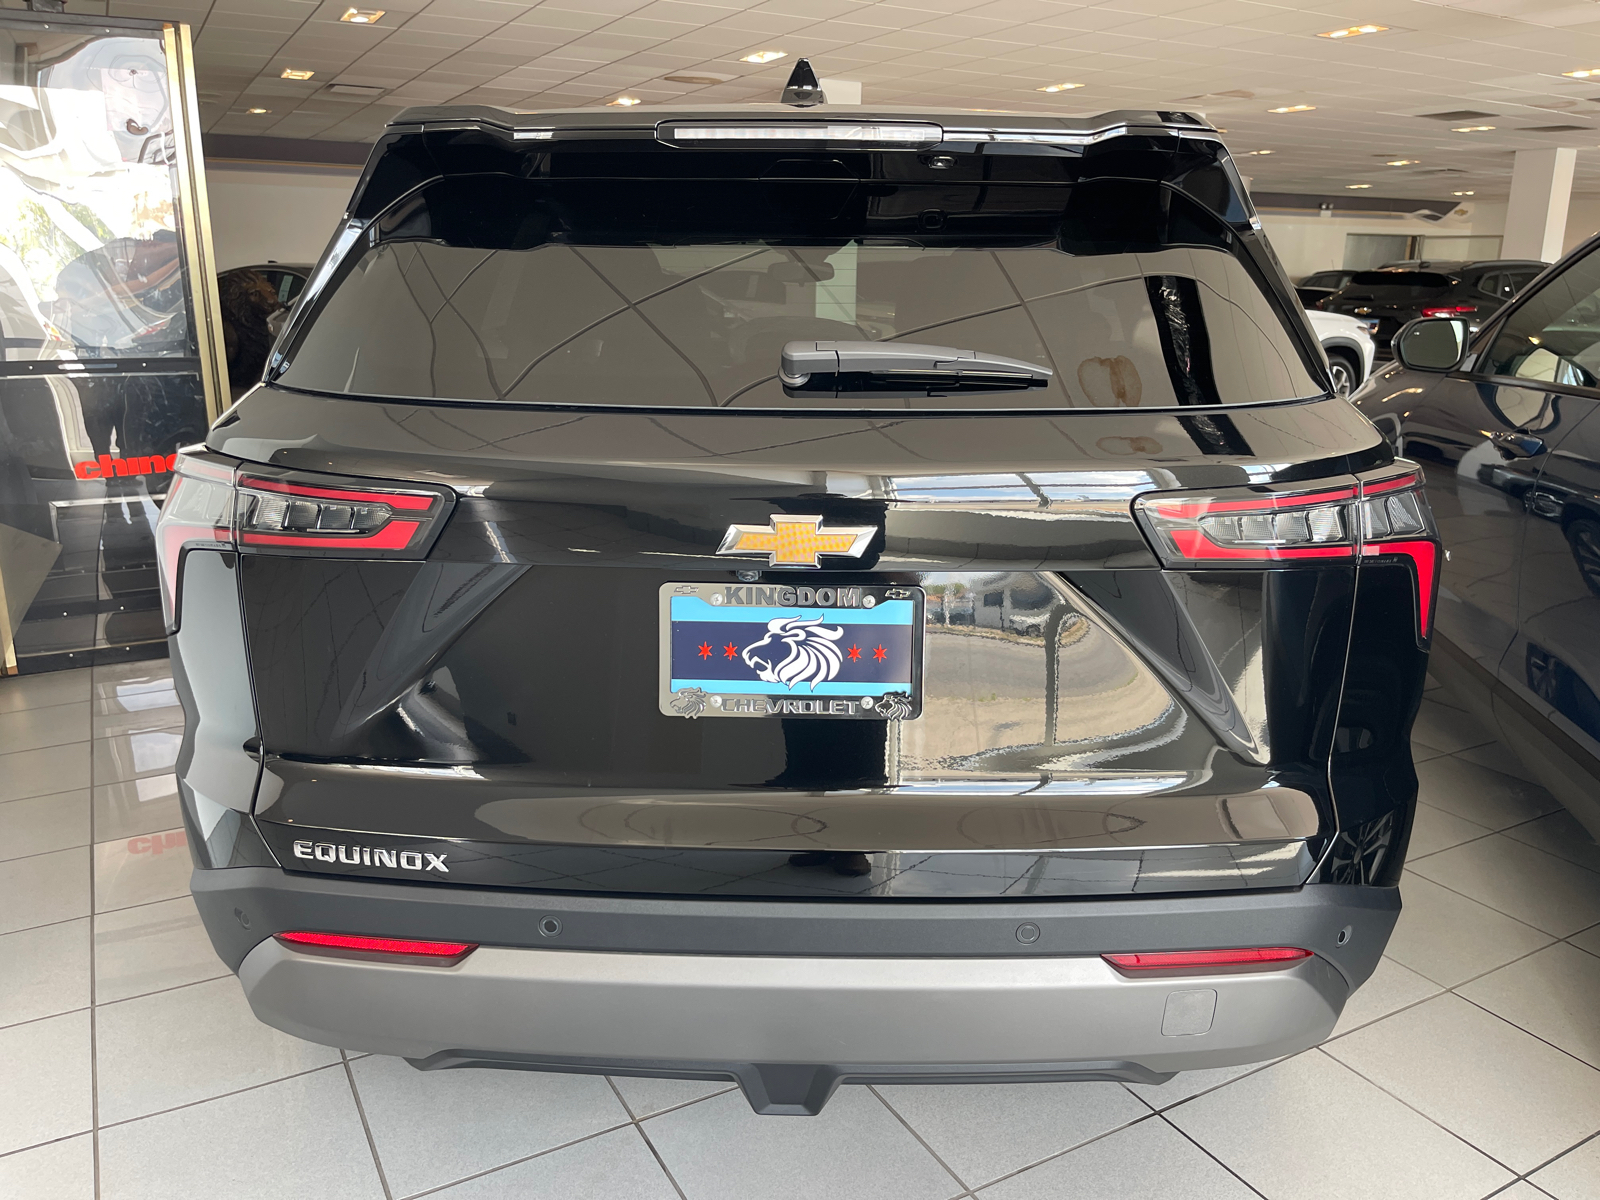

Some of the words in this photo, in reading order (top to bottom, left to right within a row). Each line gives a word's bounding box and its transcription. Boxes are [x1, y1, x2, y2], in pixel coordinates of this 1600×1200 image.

[724, 586, 861, 607] KINGDOM
[720, 696, 860, 715] CHEVROLET
[293, 840, 449, 873] EQUINOX
